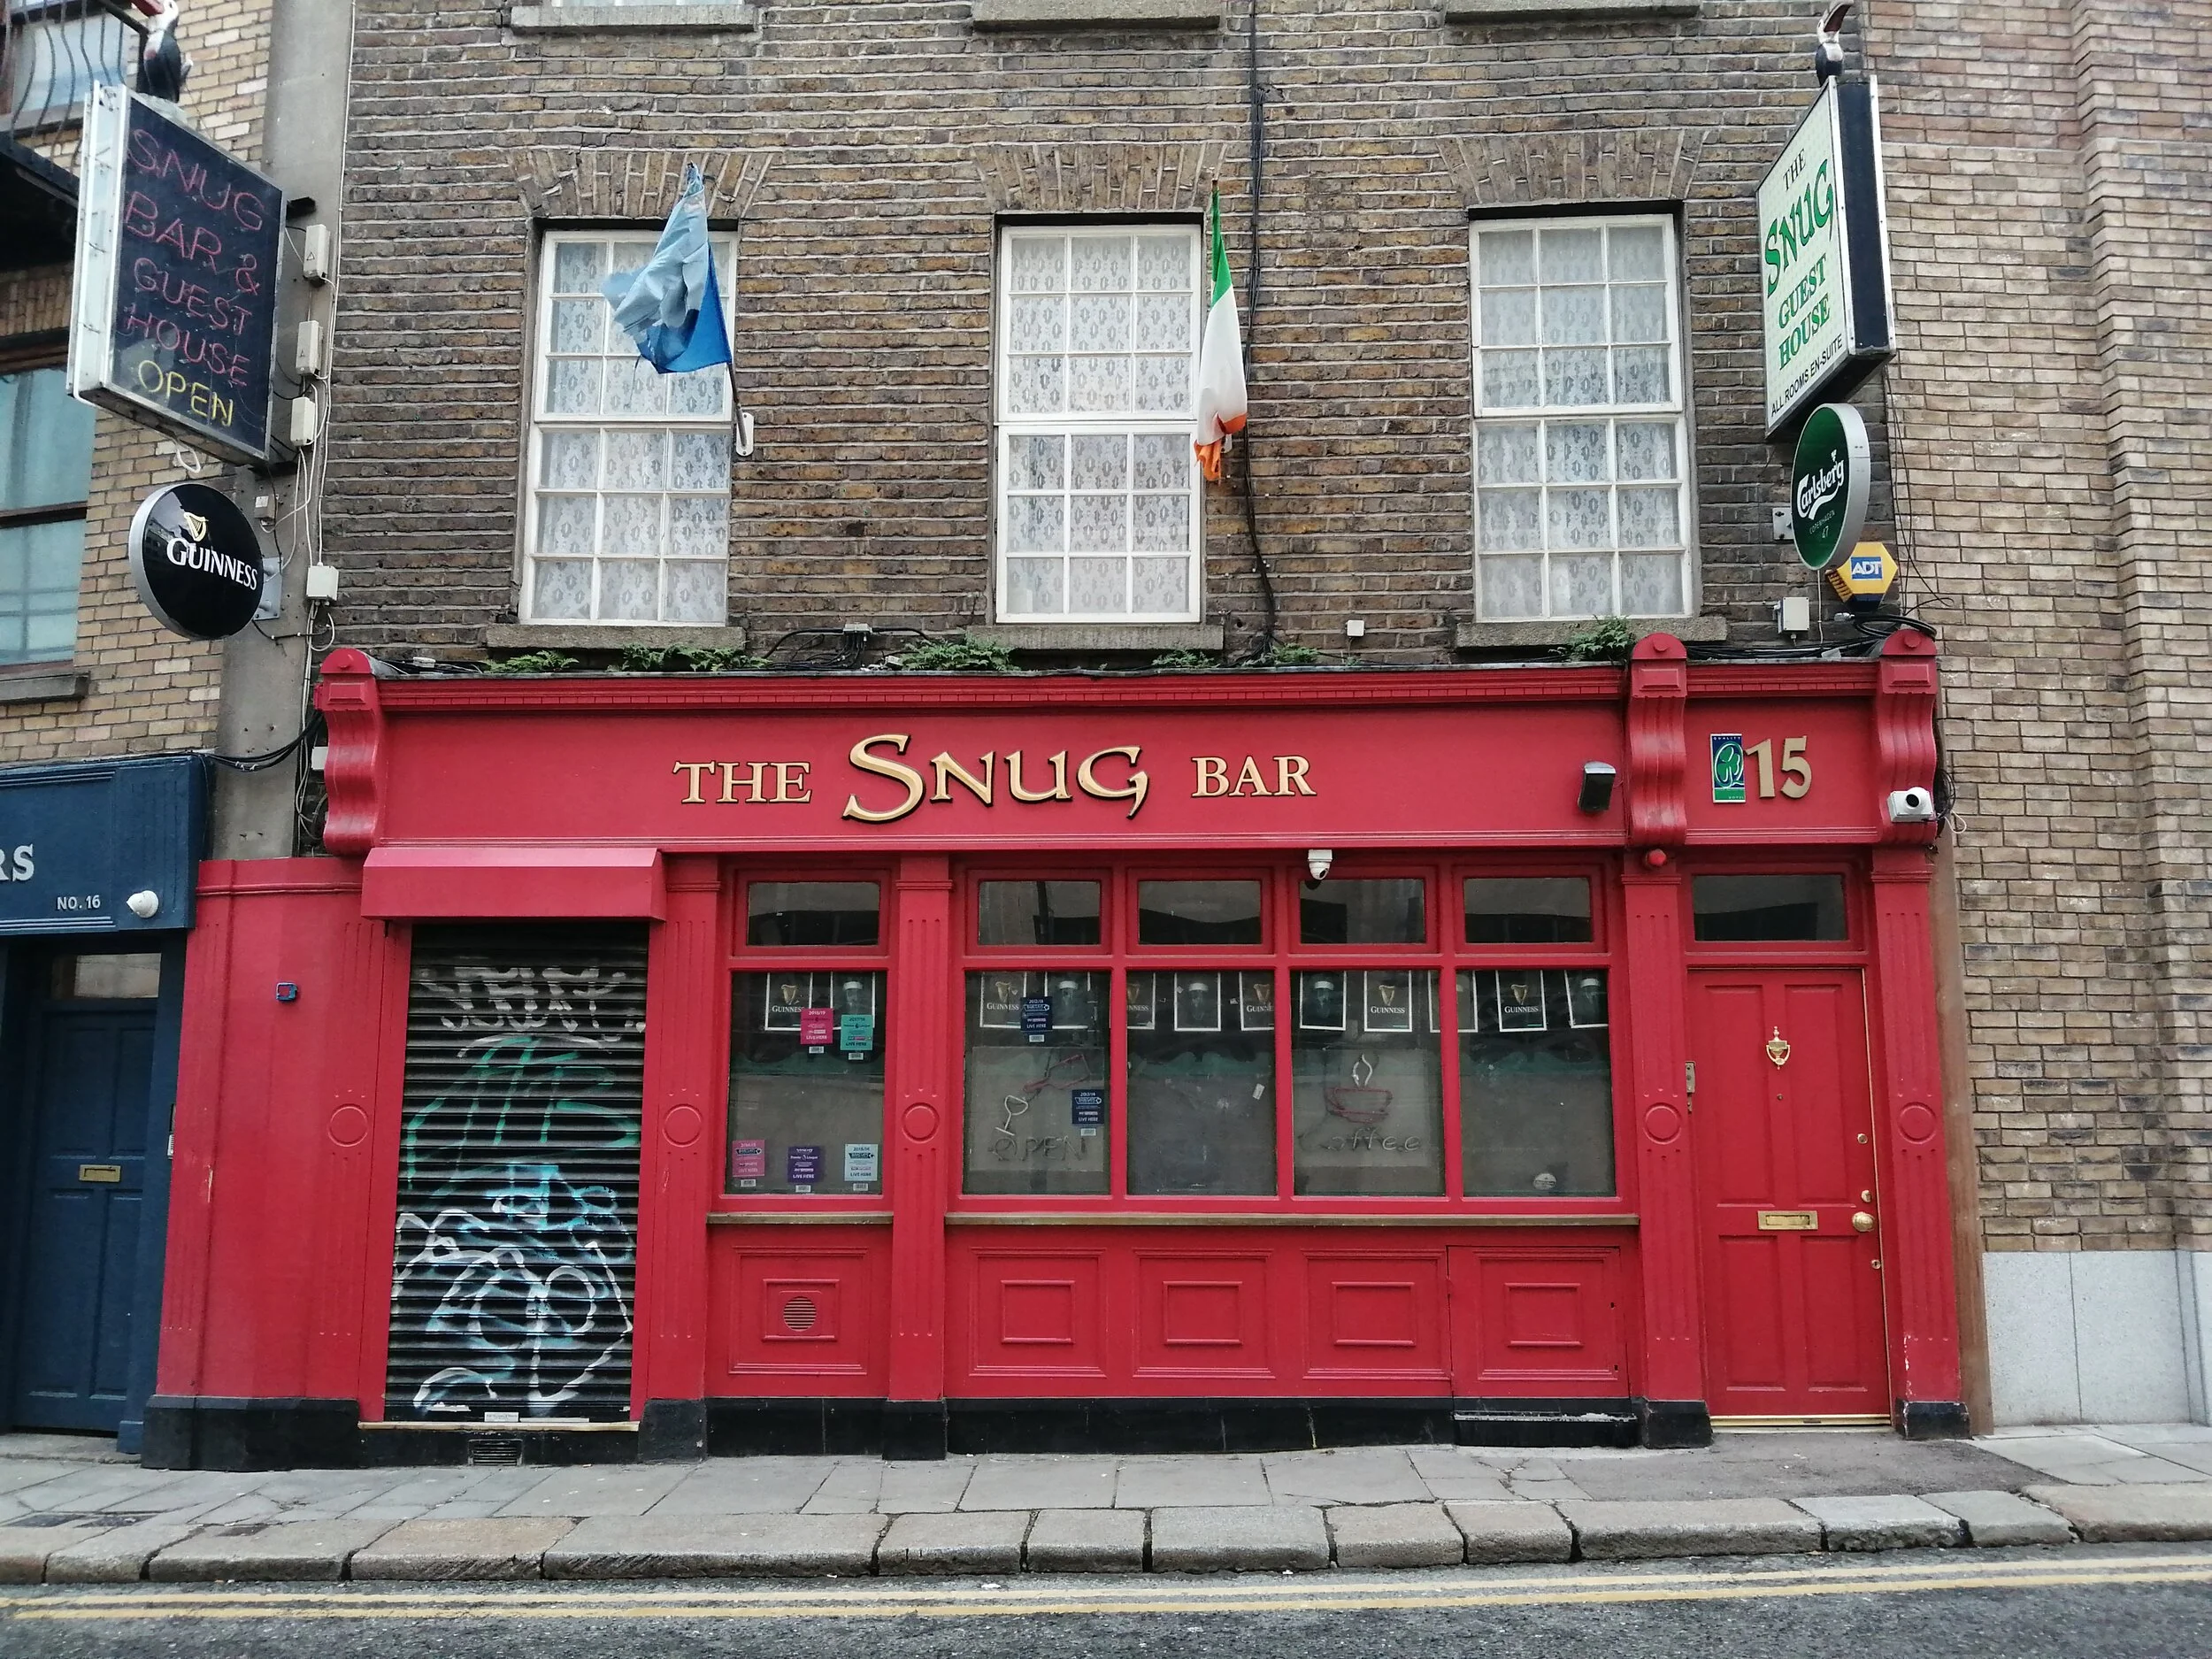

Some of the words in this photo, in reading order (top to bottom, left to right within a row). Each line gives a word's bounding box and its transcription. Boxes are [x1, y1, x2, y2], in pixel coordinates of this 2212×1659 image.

[127, 128, 265, 231] SNUG
[1783, 149, 1806, 191] THE
[126, 191, 221, 275] BAR
[236, 253, 260, 296] &
[1765, 158, 1833, 299] SNUG
[134, 257, 252, 335] GUEST
[1778, 253, 1826, 329] GUEST
[127, 303, 250, 387] HOUSE
[1779, 293, 1830, 371] HOUSE
[138, 359, 234, 426] OPEN
[1771, 396, 1784, 418] ALL
[1785, 369, 1809, 403] ROOMS
[1810, 334, 1842, 377] EN-SUITE
[1797, 457, 1844, 519] Carlsberg
[166, 537, 258, 591] GUINNESS
[1851, 560, 1880, 575] ADT
[672, 760, 812, 804] THE
[841, 733, 1151, 824] SNUG
[1191, 755, 1317, 798] BAR
[1745, 735, 1812, 799] 15
[57, 895, 83, 910] NO.
[86, 895, 101, 910] 16
[986, 1002, 1019, 1011] GUINNESS
[1370, 1005, 1405, 1014] GUINNESS
[1504, 1005, 1539, 1014] GUINNESS
